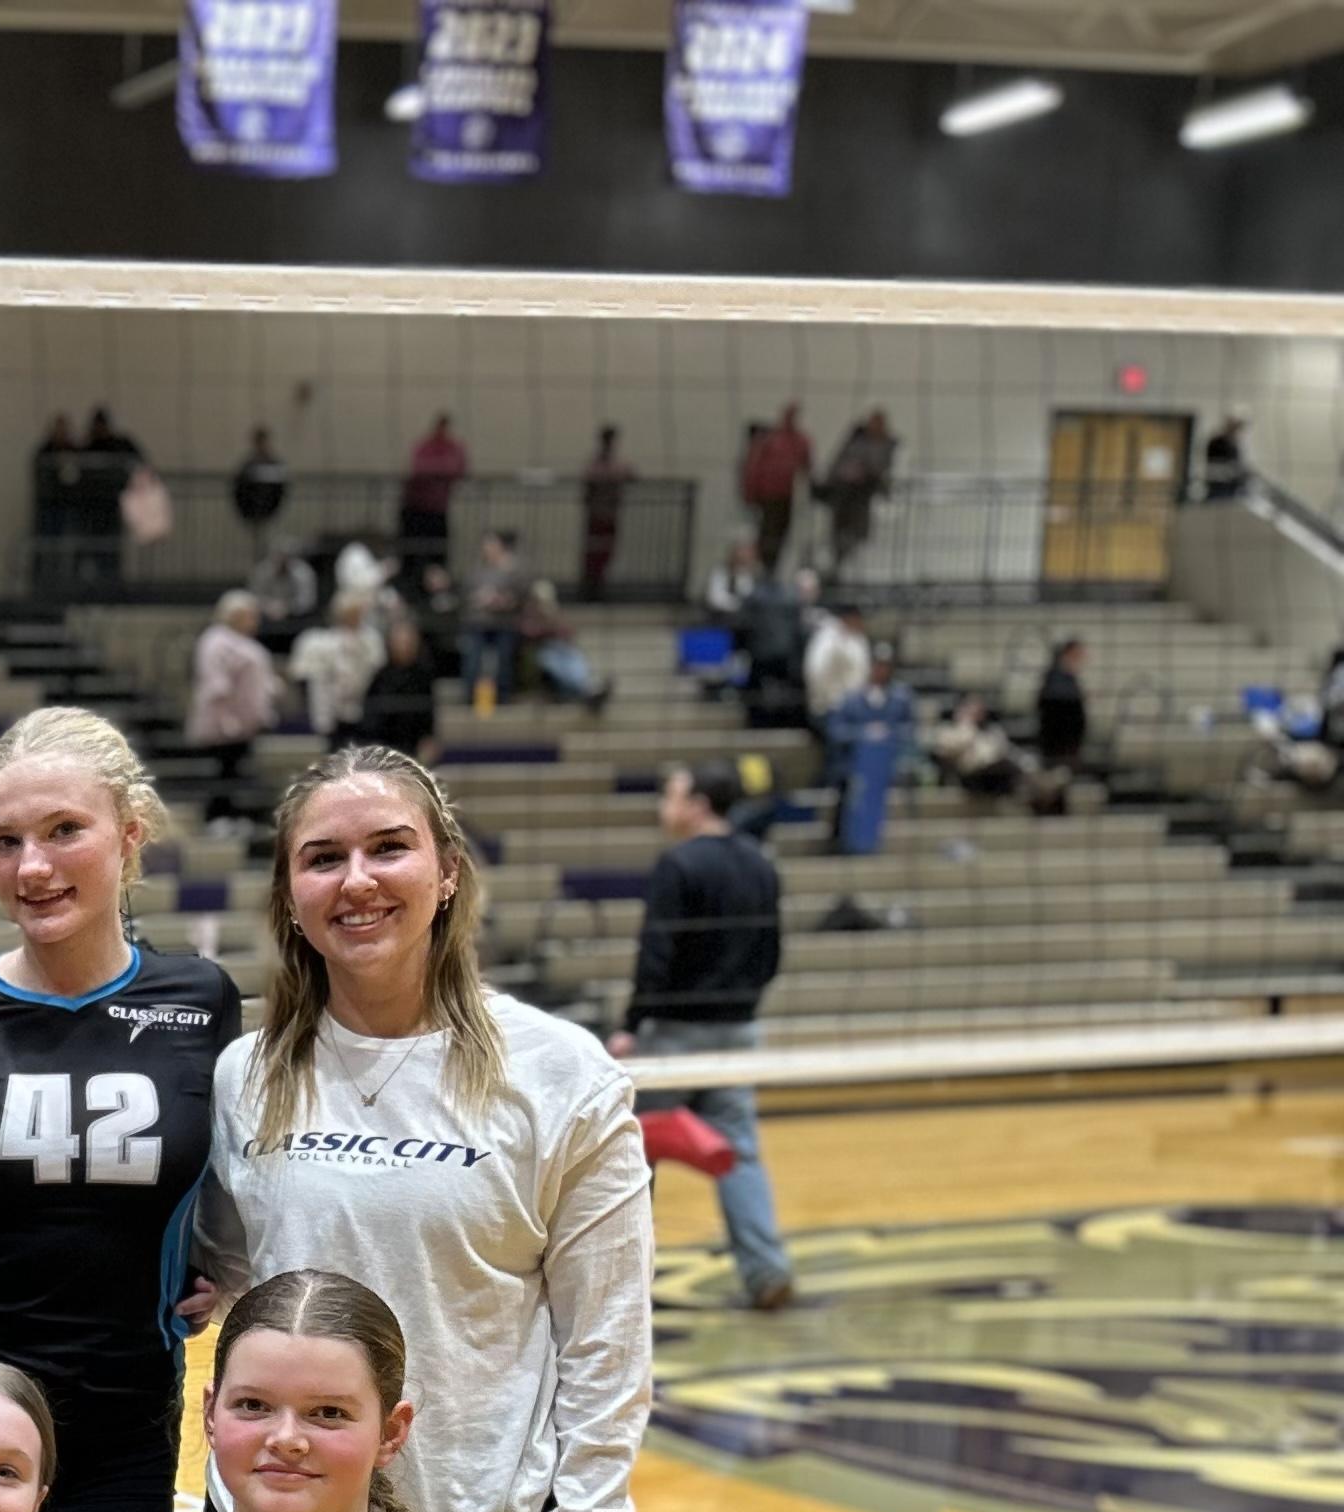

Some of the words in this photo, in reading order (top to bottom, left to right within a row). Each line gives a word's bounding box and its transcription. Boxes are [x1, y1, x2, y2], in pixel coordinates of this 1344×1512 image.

[108, 1005, 175, 1023] CLASSIC
[177, 1012, 212, 1026] CITY
[286, 1152, 413, 1169] VOLLEYBALL
[393, 1138, 492, 1168] CITY
